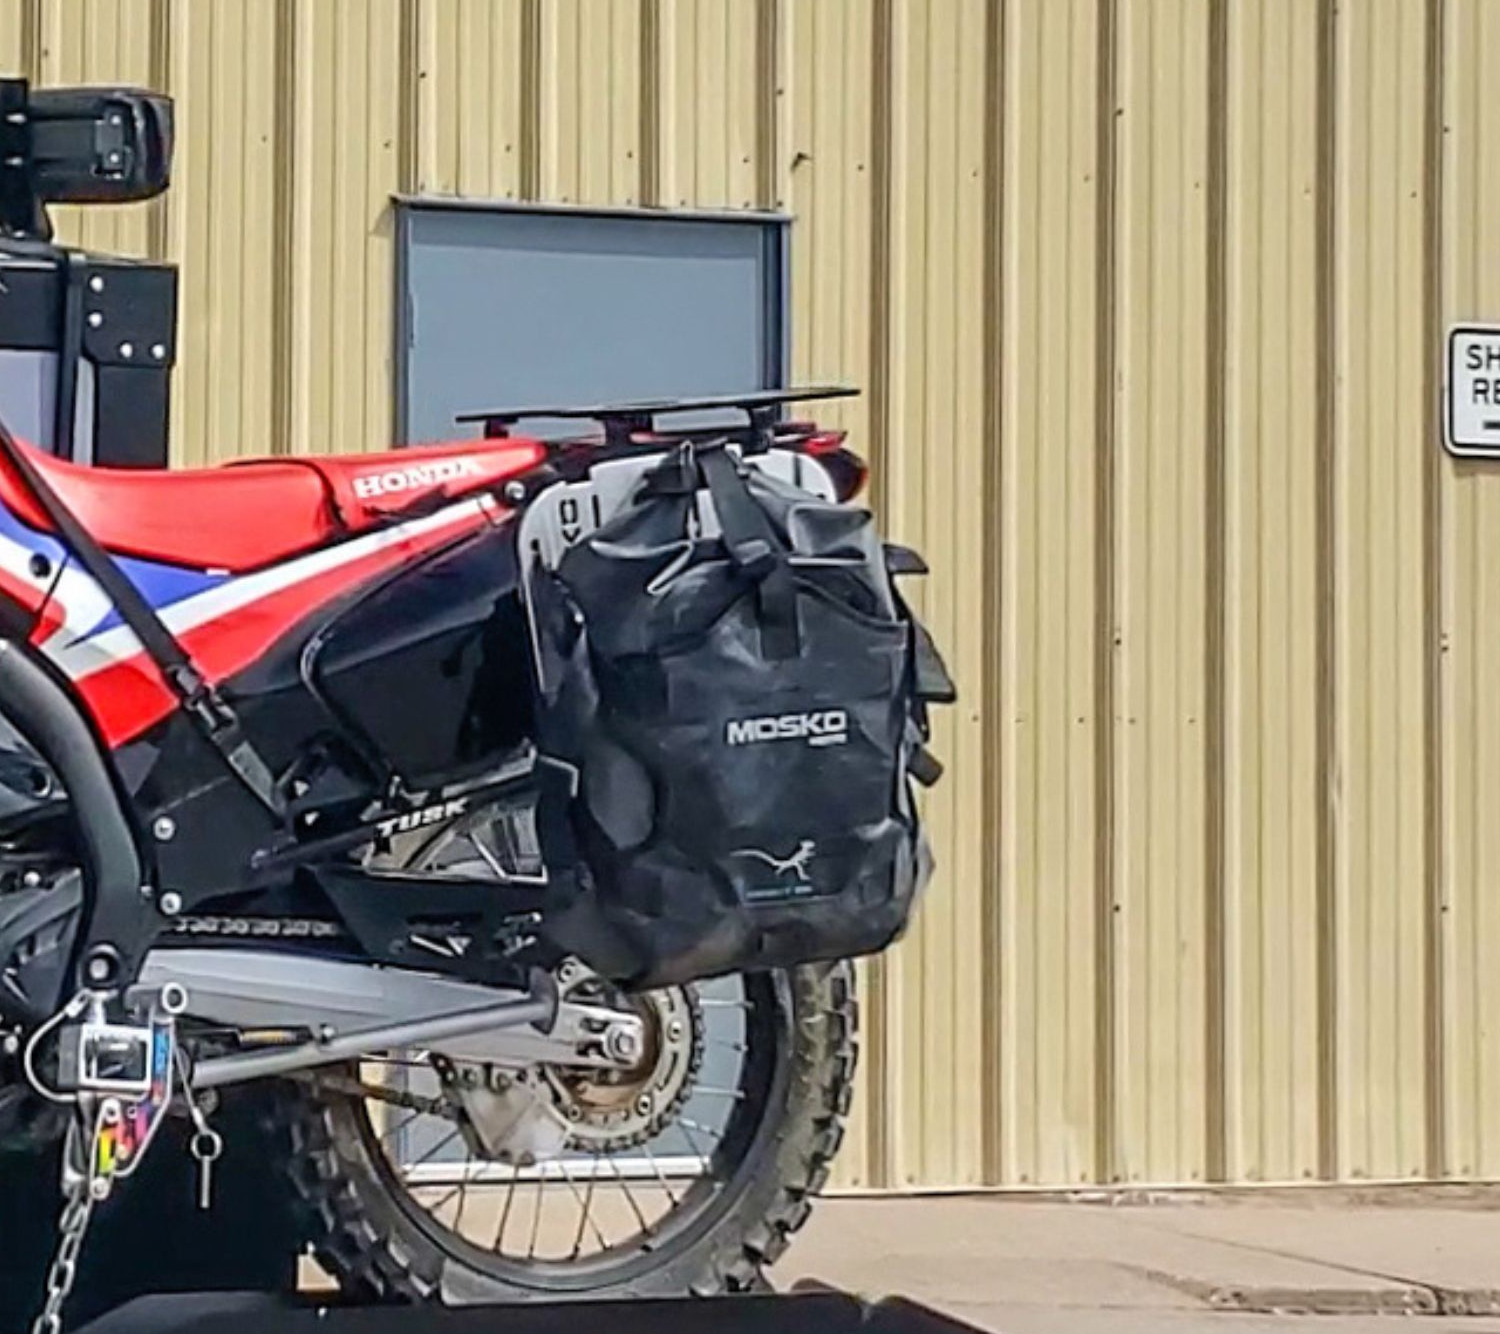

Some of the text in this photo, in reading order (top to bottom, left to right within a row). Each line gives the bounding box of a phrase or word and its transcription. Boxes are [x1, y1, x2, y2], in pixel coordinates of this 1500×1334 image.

[352, 458, 484, 499] HONDA
[727, 711, 847, 745] MOSKO
[376, 796, 471, 838] TUSK
